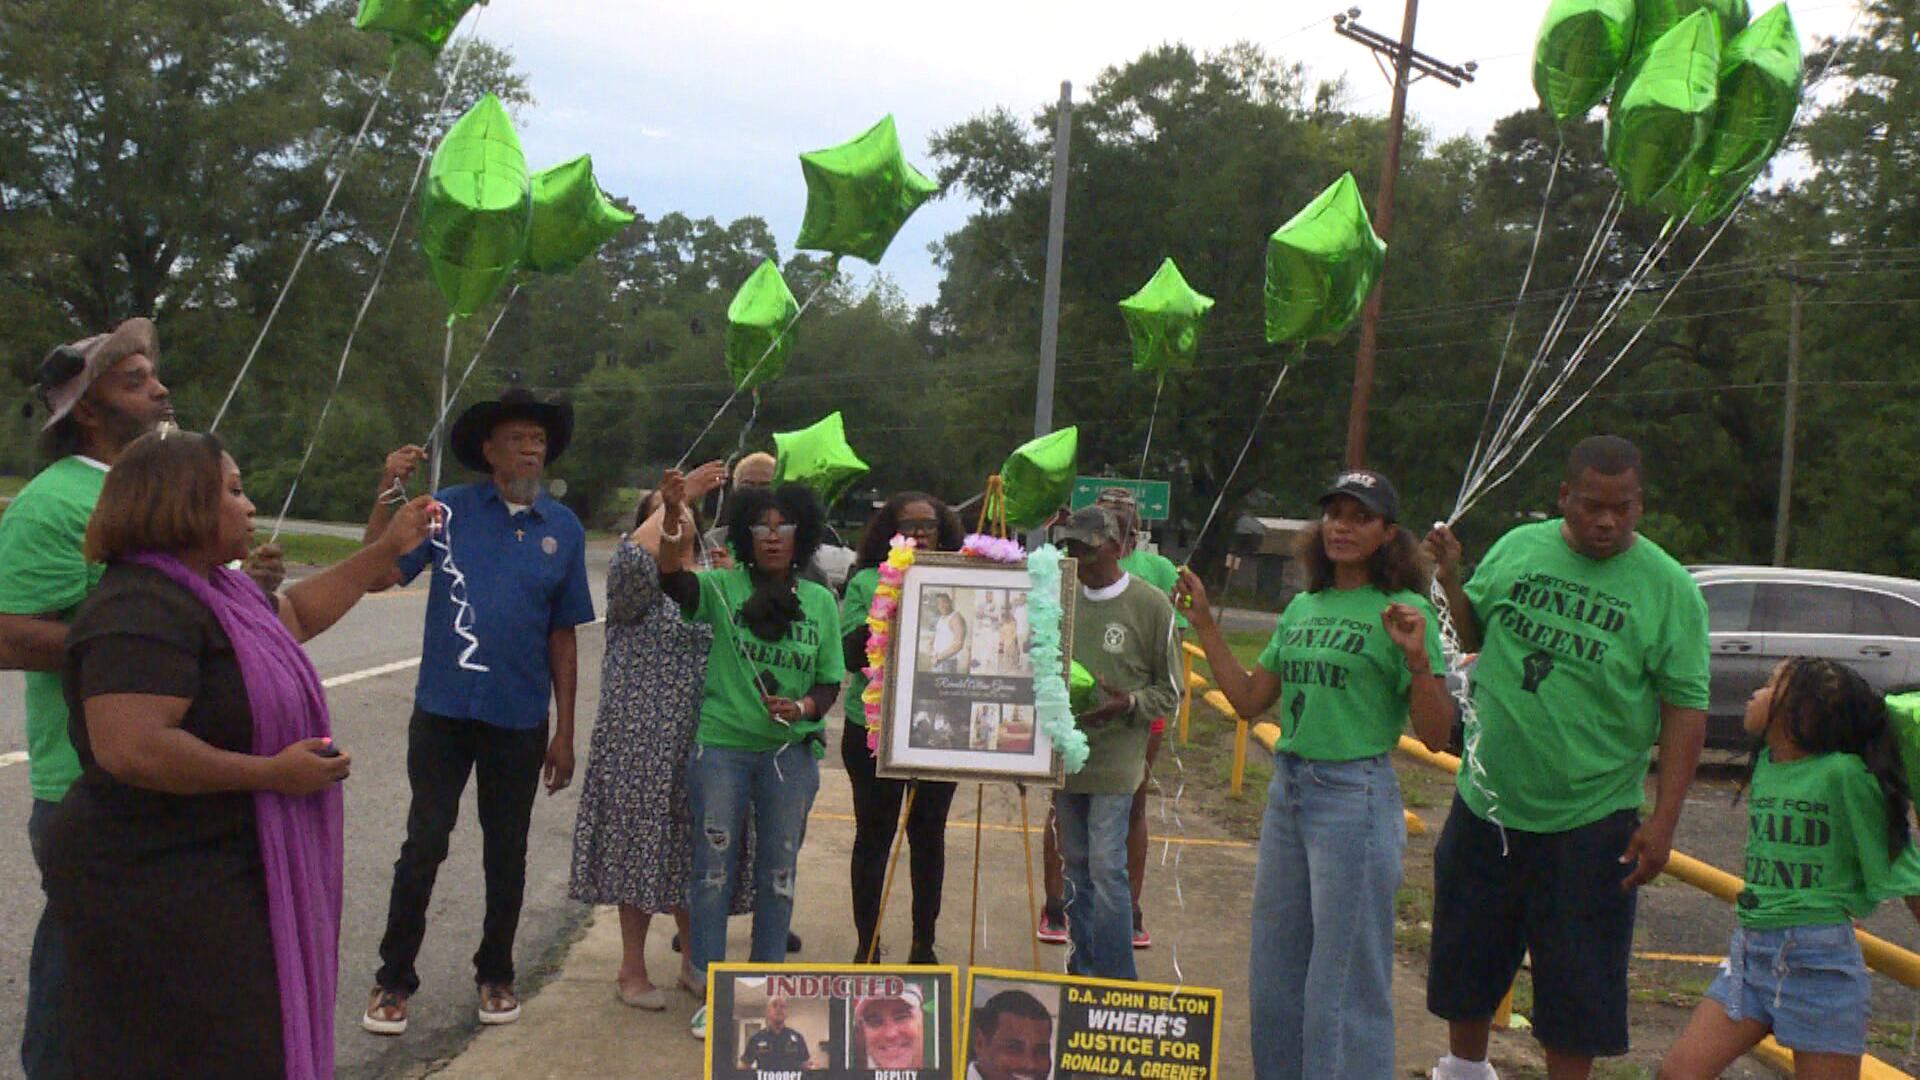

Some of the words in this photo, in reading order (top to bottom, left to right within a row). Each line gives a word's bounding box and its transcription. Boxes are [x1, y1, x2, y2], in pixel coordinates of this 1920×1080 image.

[1511, 581, 1626, 632] RONALD
[1500, 603, 1609, 664] GREENE
[1783, 799, 1829, 816] FOR
[766, 974, 905, 1000] INDICTED
[1068, 987, 1097, 1003] D.A.
[1102, 991, 1145, 1008] JOHN
[1149, 996, 1209, 1015] BELTON
[1088, 1009, 1188, 1038] WHERE'S
[1067, 1032, 1154, 1057] JUSTICE
[1159, 1040, 1200, 1060] FOR
[1060, 1053, 1120, 1074] RONALD
[1122, 1059, 1136, 1076] A.
[1140, 1061, 1208, 1080] GREENE?
